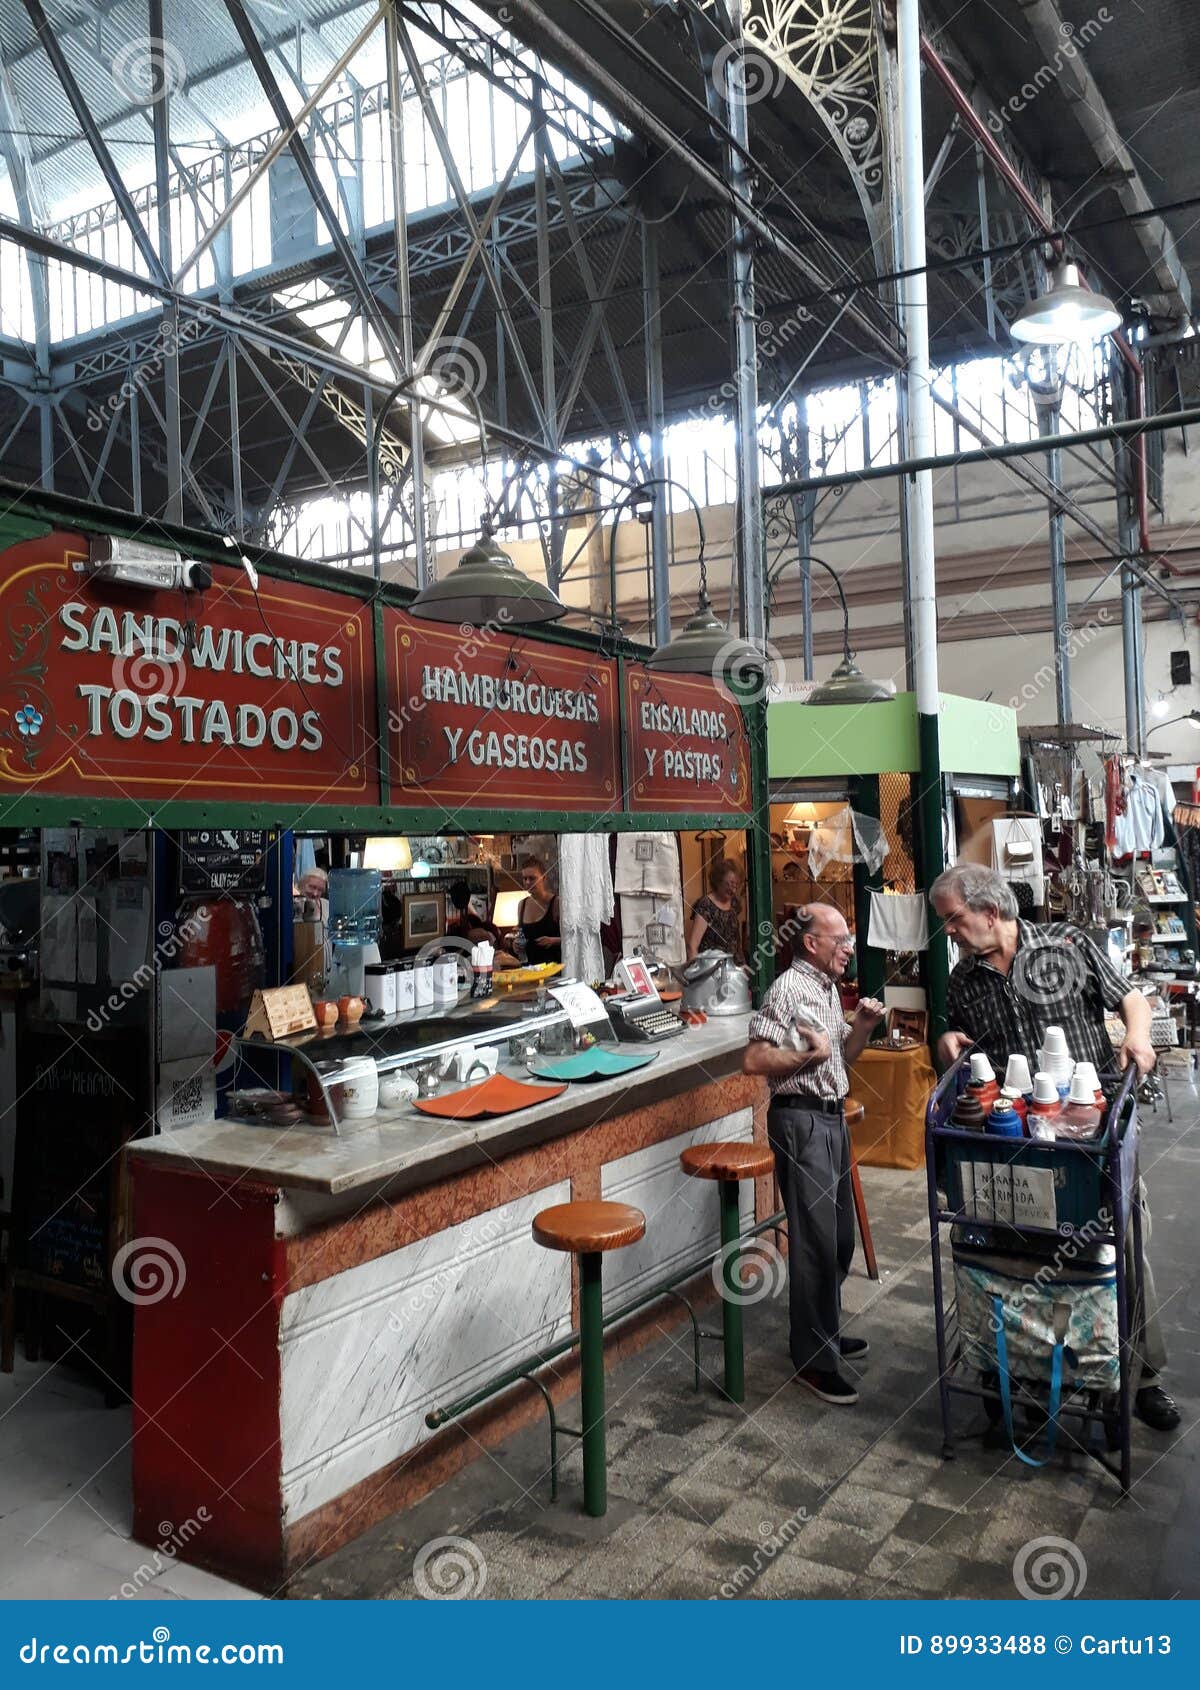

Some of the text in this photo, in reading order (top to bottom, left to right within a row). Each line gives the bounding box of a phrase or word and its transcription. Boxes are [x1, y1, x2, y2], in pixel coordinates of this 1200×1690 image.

[59, 602, 344, 687] SANDWICHES
[78, 684, 324, 752] TOSTADOS
[422, 665, 599, 723] HAMBURGUESAS
[641, 701, 727, 739] ENSALADAS
[443, 726, 588, 773] Y GASEOSAS
[644, 748, 721, 781] Y PASTAS
